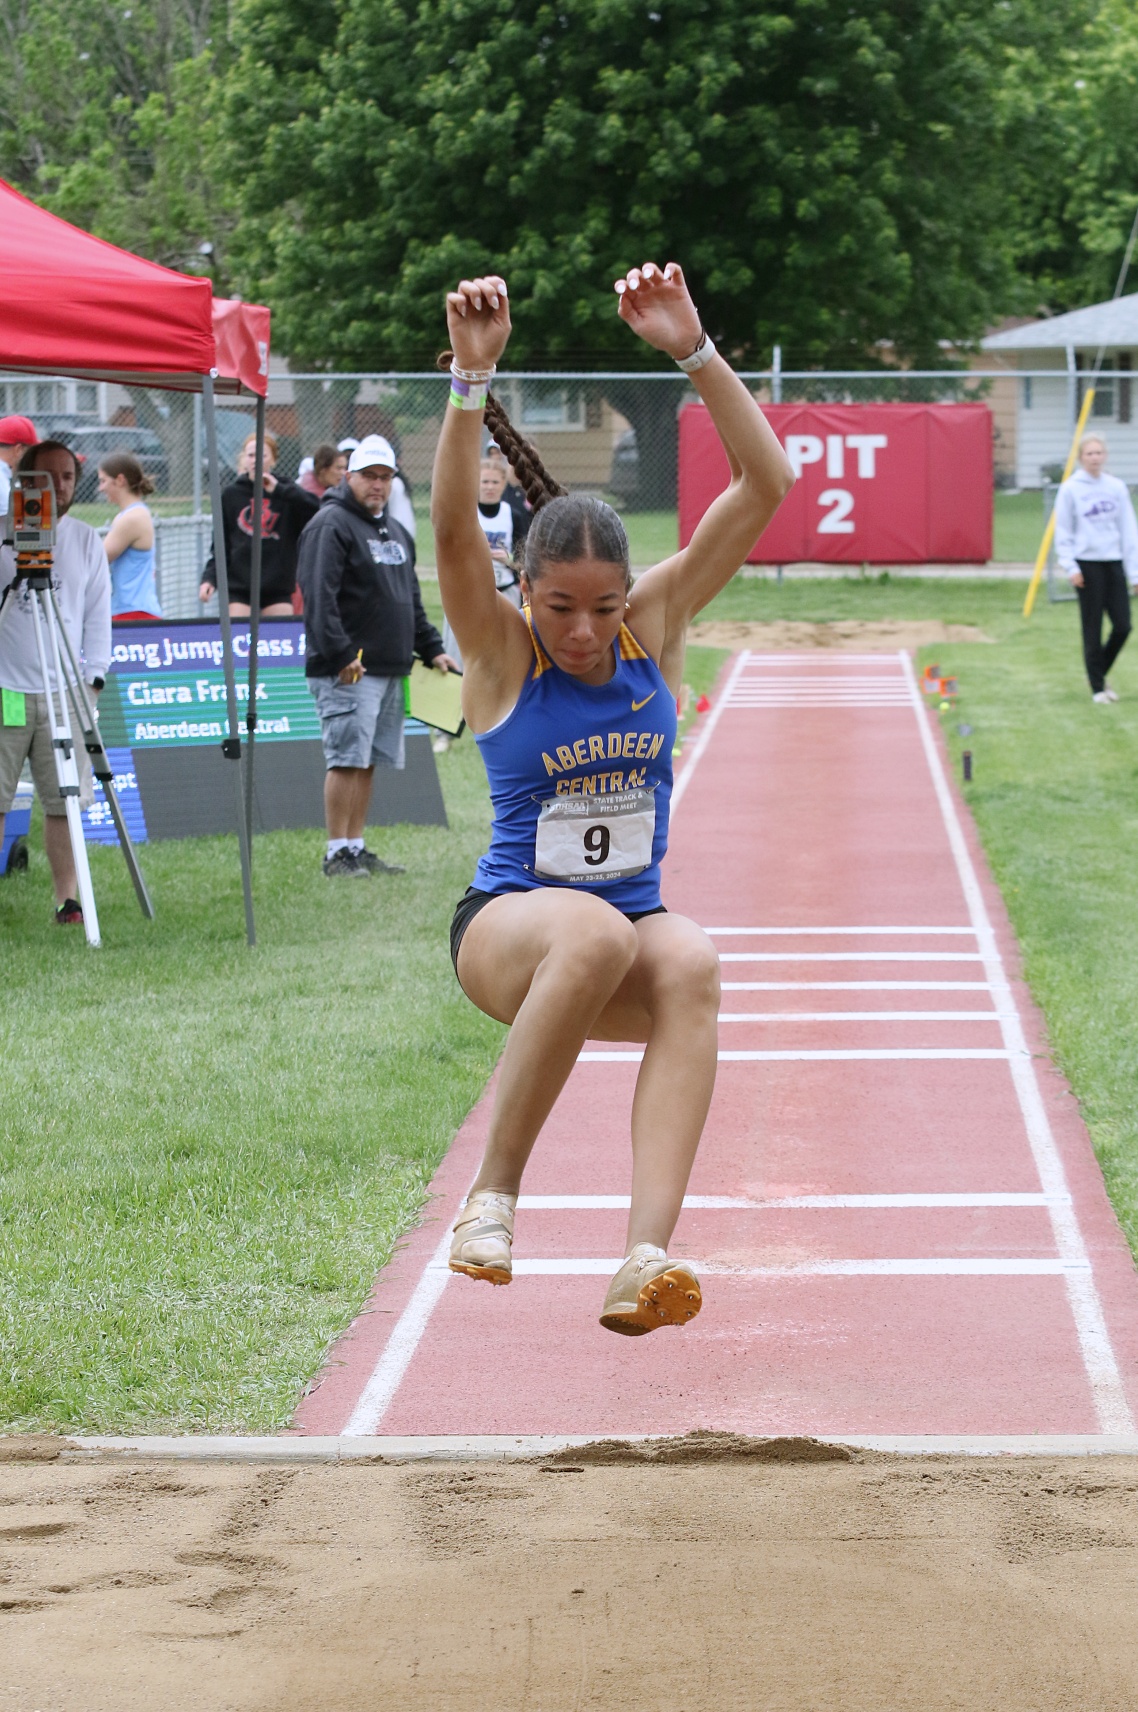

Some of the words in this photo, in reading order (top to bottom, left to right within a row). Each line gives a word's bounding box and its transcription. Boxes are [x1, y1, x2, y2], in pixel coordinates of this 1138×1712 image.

[785, 434, 888, 479] PIT
[817, 488, 855, 534] 2
[110, 642, 161, 669] ong
[163, 638, 223, 666] Jump
[127, 681, 193, 706] Ciara
[135, 721, 222, 740] Aberdeen
[225, 716, 291, 735] etral
[541, 732, 665, 777] ABERDEEN
[555, 766, 647, 796] CENTRAL
[593, 796, 614, 805] STATE
[615, 793, 637, 803] TRACK
[600, 804, 619, 813] FIELD
[620, 801, 638, 811] MEET
[583, 825, 610, 866] 9
